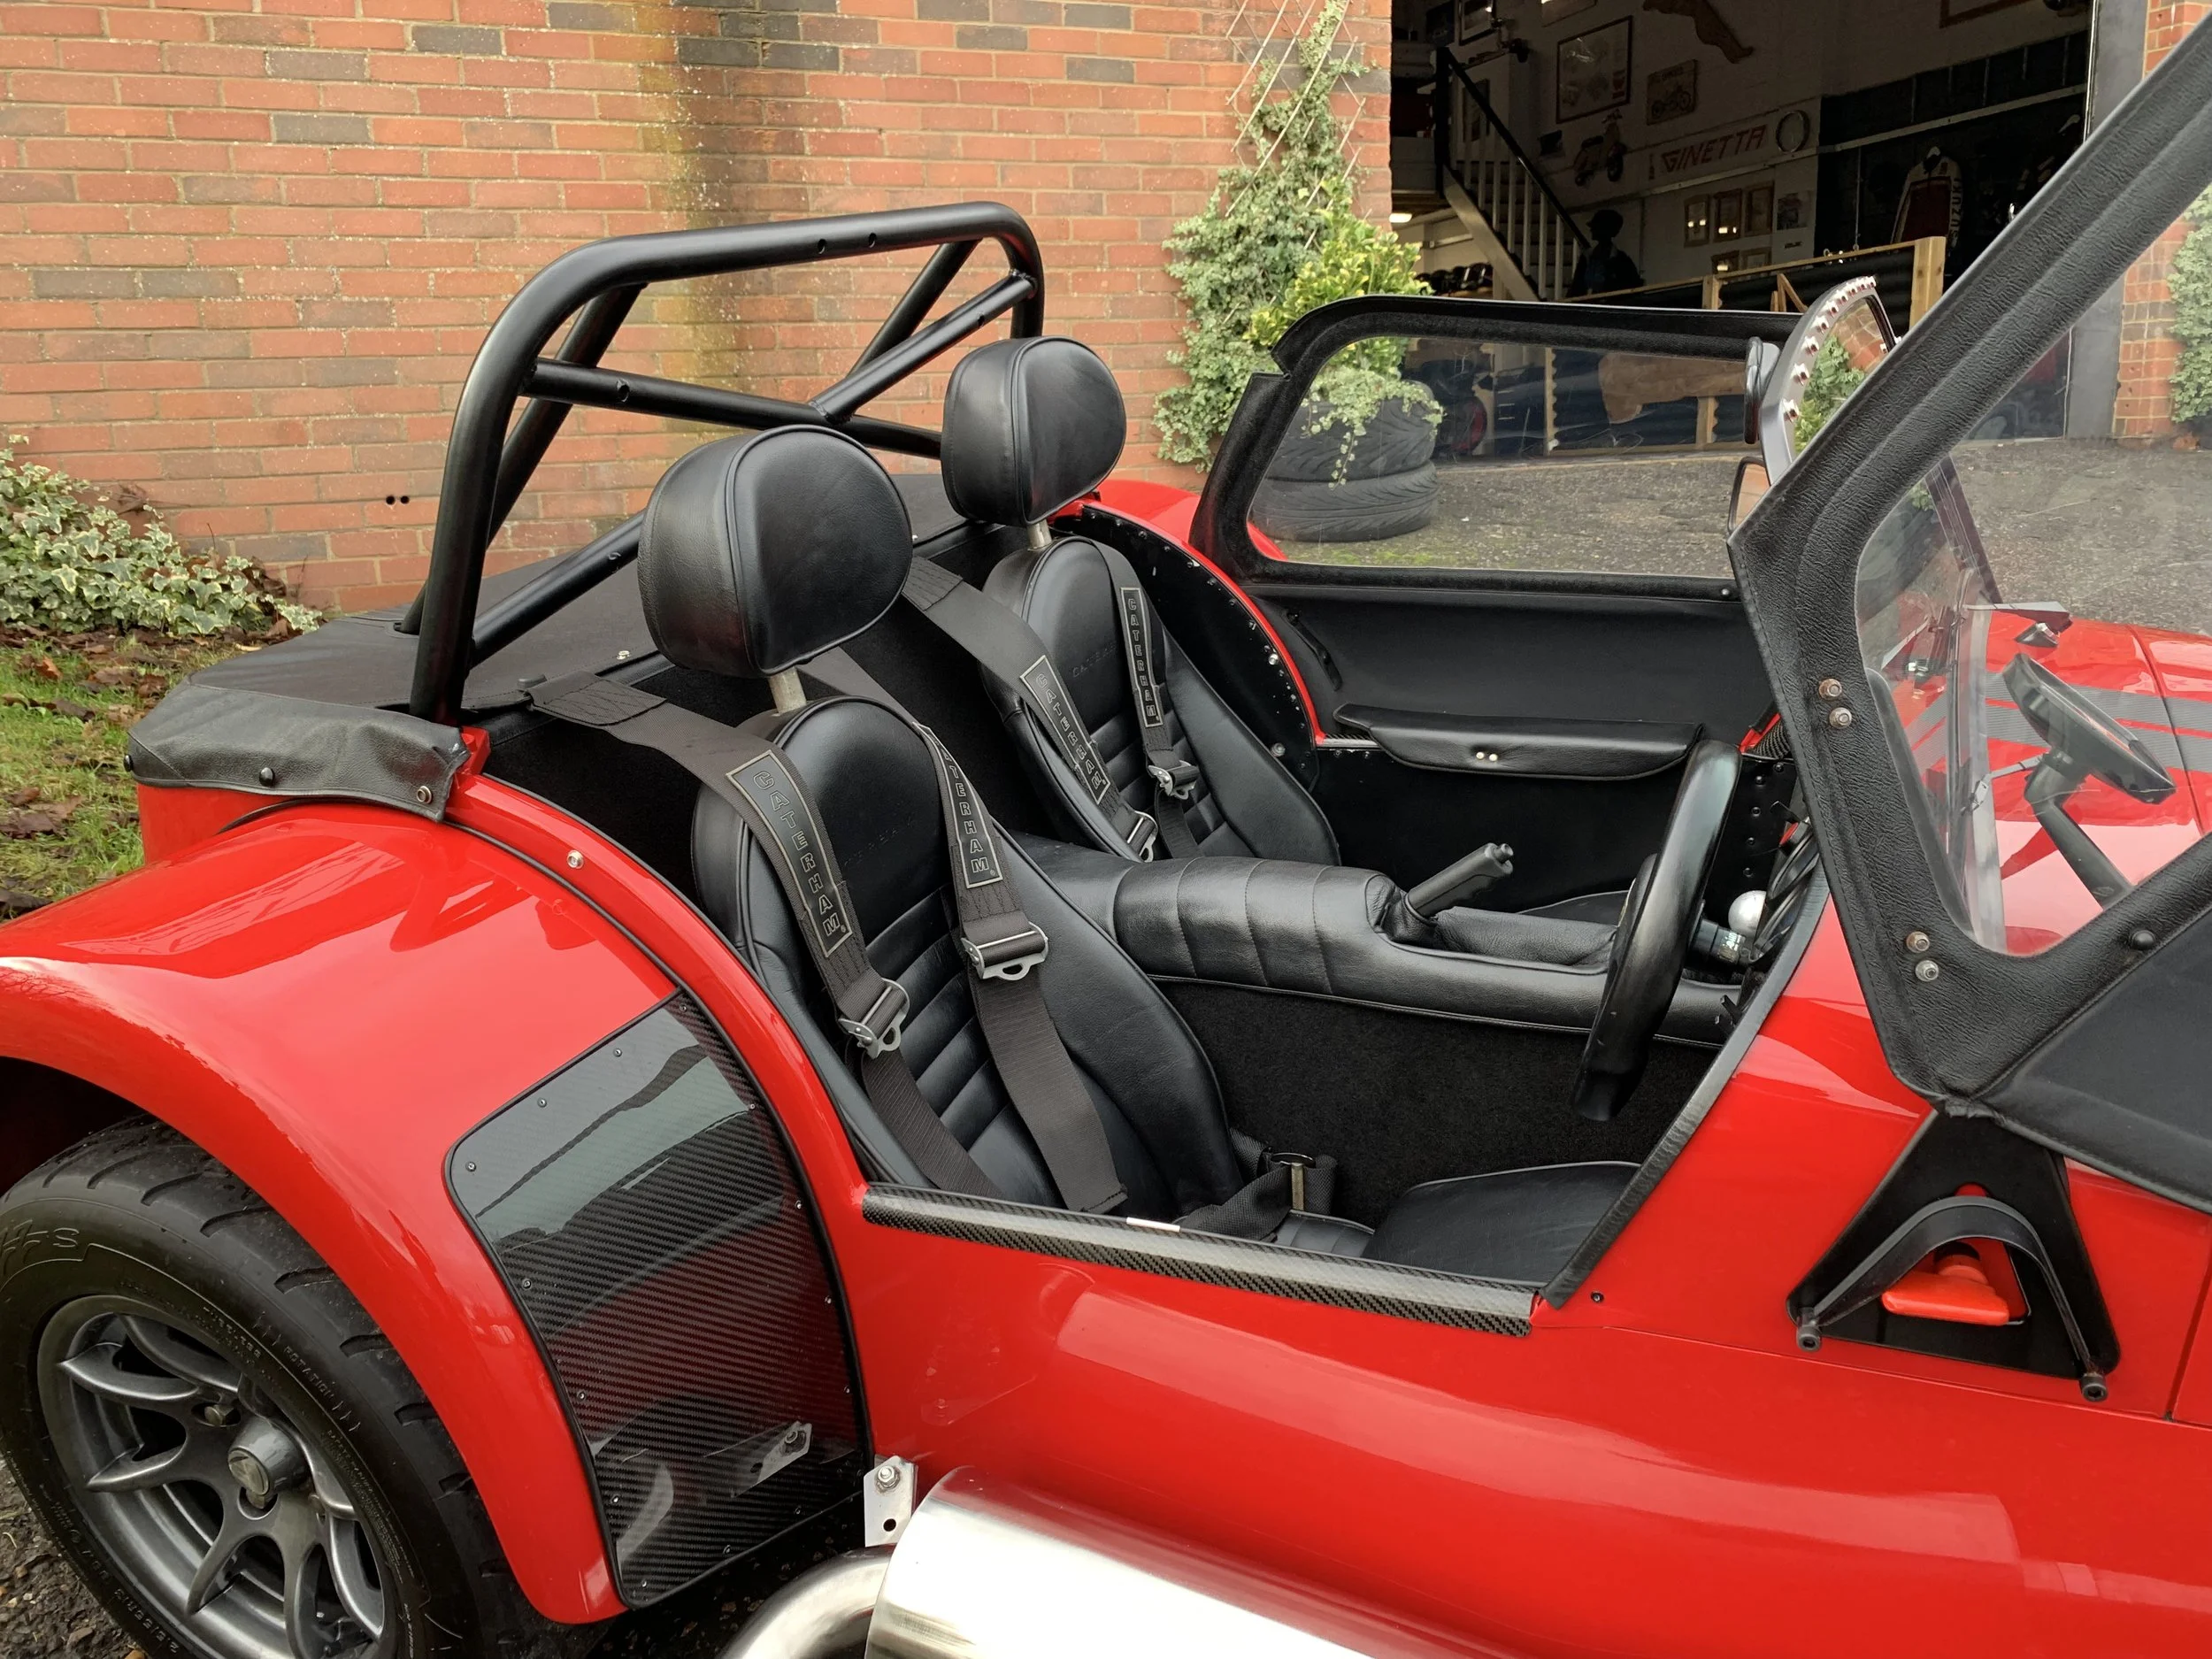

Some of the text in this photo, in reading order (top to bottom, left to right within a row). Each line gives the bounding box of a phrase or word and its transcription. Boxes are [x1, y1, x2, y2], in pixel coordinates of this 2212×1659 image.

[1662, 124, 1768, 173] GINETTA
[1949, 177, 1962, 237] SUZUKI
[1127, 598, 1156, 718] CATERHAM
[1036, 673, 1102, 790] CATERHAM
[753, 771, 841, 938] CATERHAM
[933, 741, 989, 873] ATERHAM
